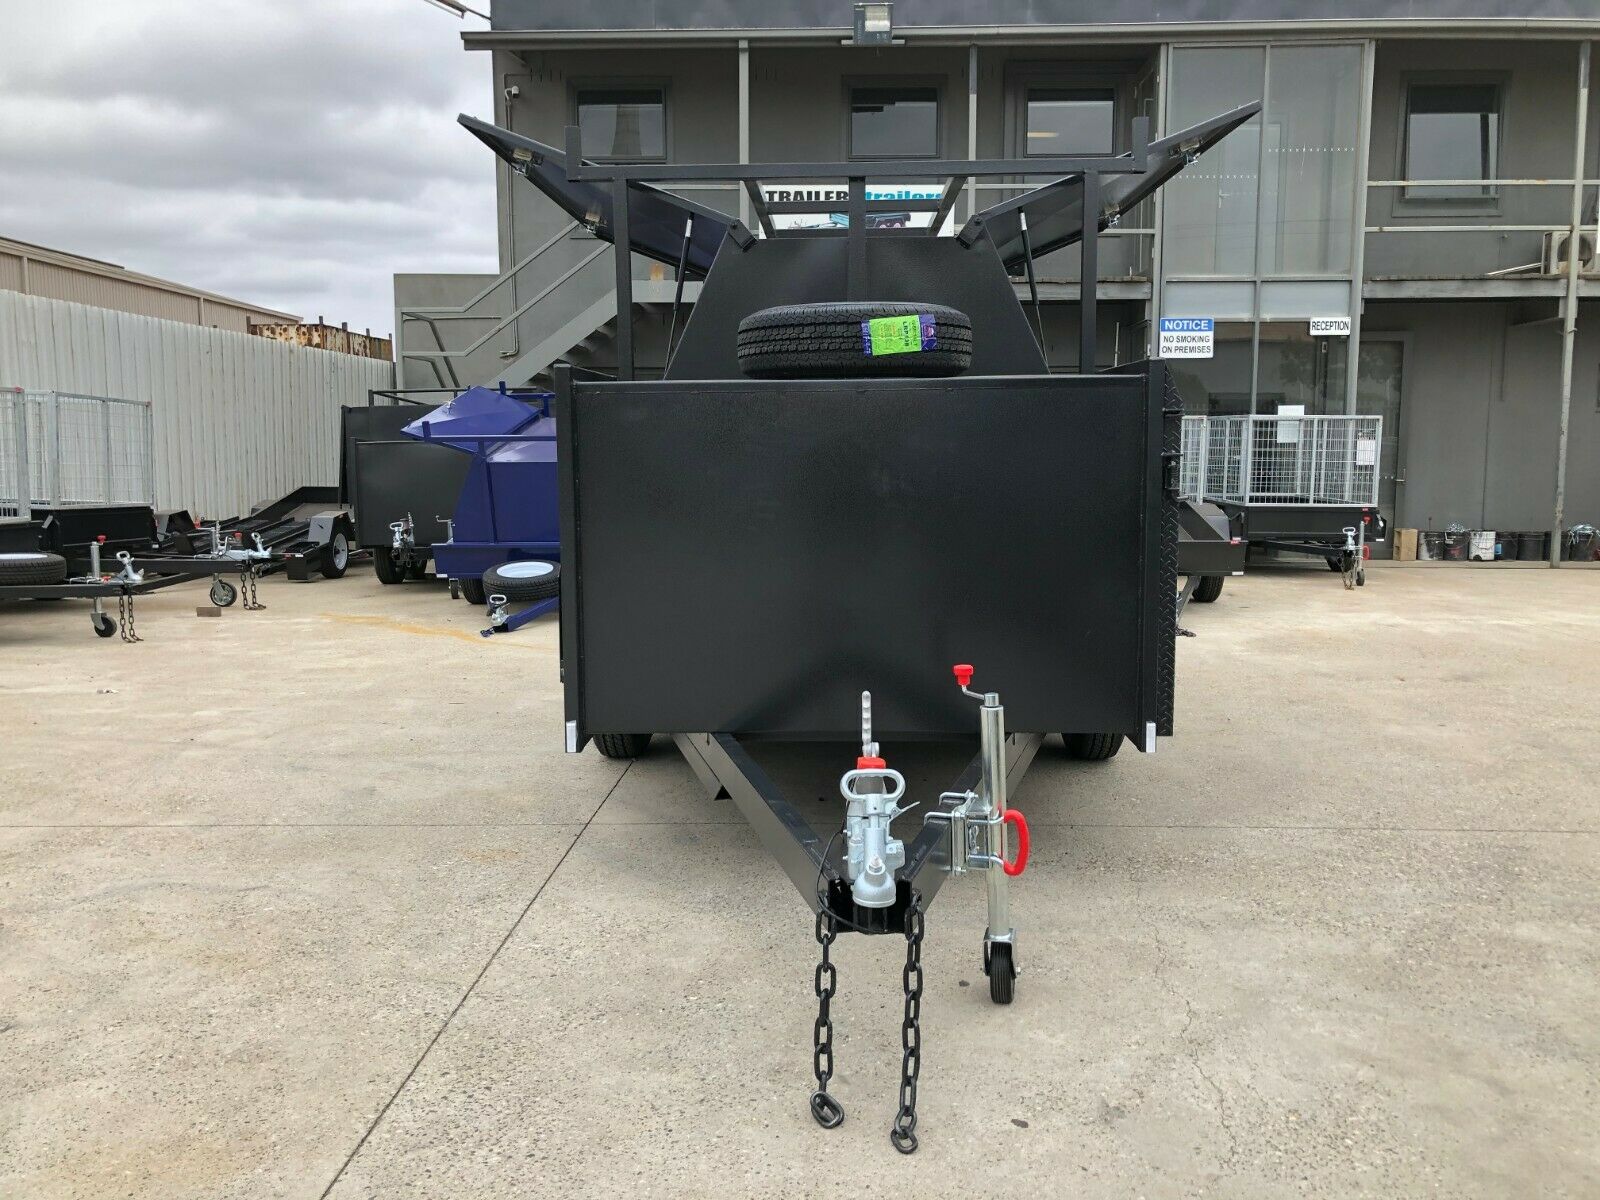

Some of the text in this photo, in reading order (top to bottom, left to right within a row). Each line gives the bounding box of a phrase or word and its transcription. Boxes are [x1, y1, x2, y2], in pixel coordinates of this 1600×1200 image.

[1164, 320, 1209, 330] NOTICE
[1311, 320, 1349, 331] RECEPTION
[1163, 335, 1210, 343] NO SMOKING
[1161, 345, 1211, 354] ON PREMISES
